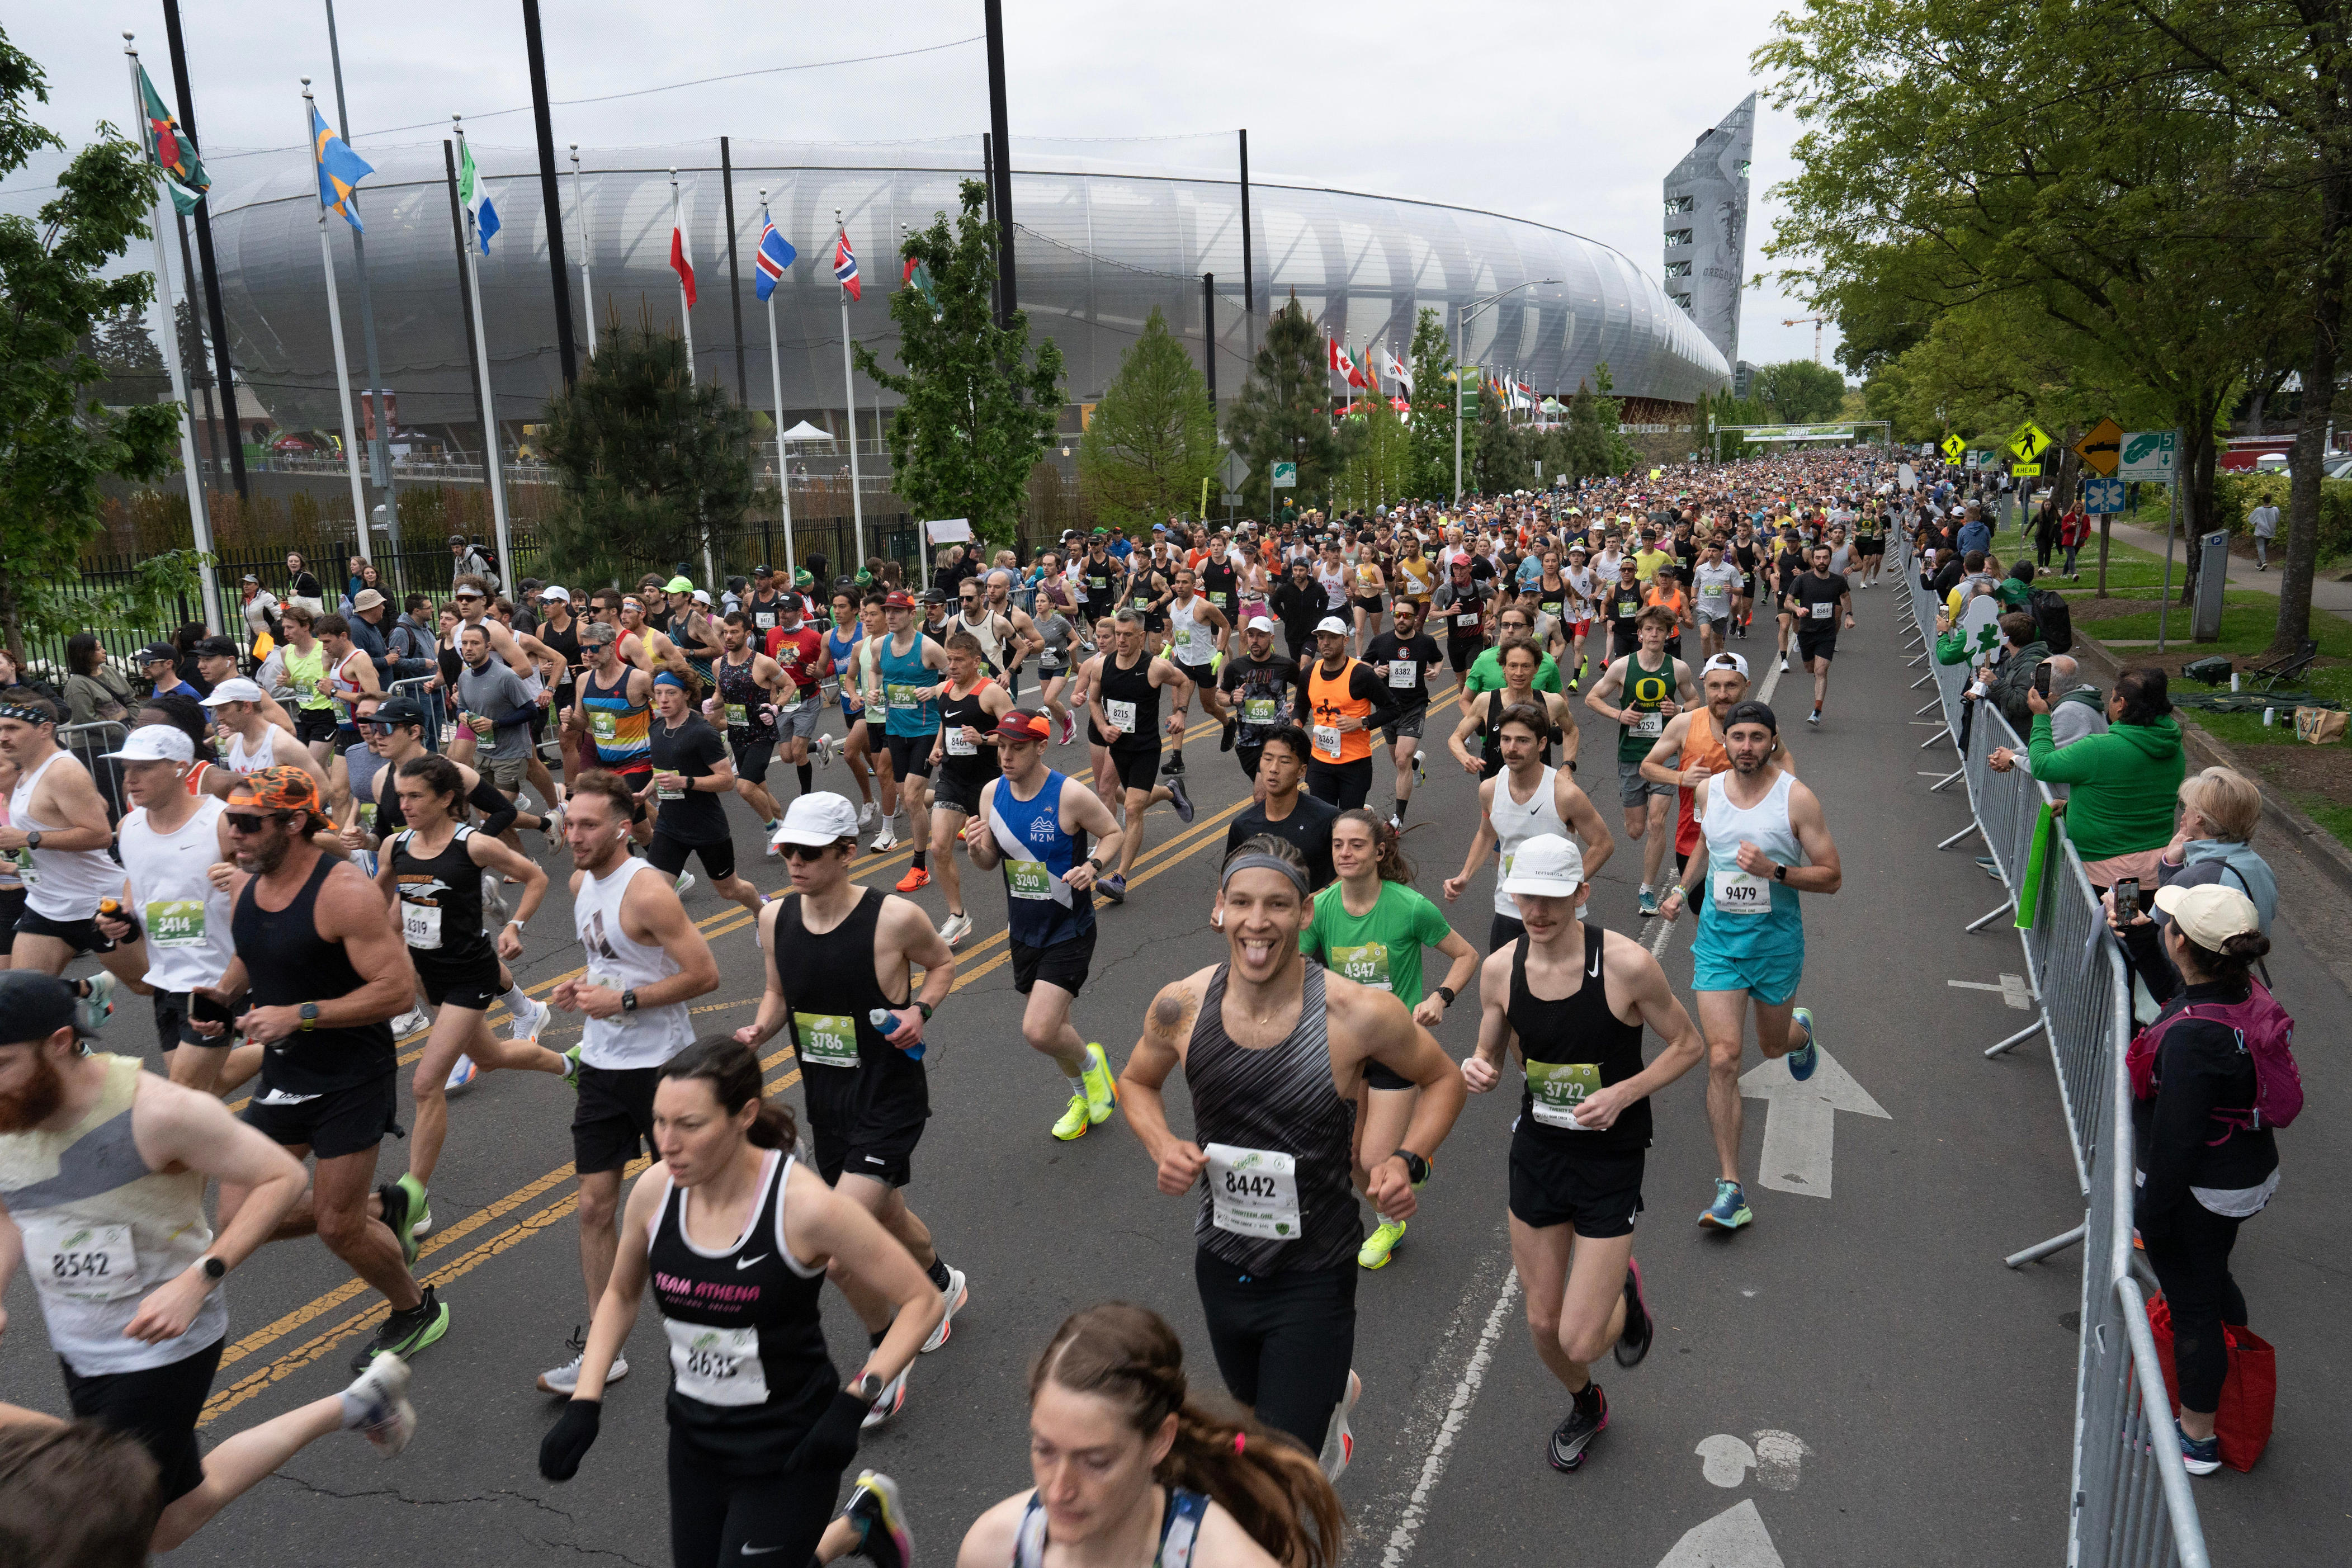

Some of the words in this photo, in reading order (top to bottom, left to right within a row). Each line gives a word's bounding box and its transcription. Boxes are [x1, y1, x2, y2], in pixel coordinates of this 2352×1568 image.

[2163, 433, 2172, 447] 5
[894, 692, 910, 701] 3756
[1635, 677, 1666, 701] O
[1113, 709, 1128, 718] 8215
[1637, 721, 1655, 730] 8252
[1319, 734, 1334, 744] 8365
[1030, 833, 1055, 842] M2M
[1015, 873, 1039, 887] 3240
[1726, 886, 1756, 900] 9479
[158, 917, 191, 933] 3414
[408, 918, 427, 934] 8319
[1344, 962, 1376, 977] 4347
[810, 1031, 843, 1050] 3786
[1543, 1080, 1586, 1099] 3722
[1226, 1170, 1276, 1198] 8442
[52, 1252, 110, 1278] 8542
[655, 1271, 692, 1296] TEAM
[694, 1281, 761, 1302] ATHENA
